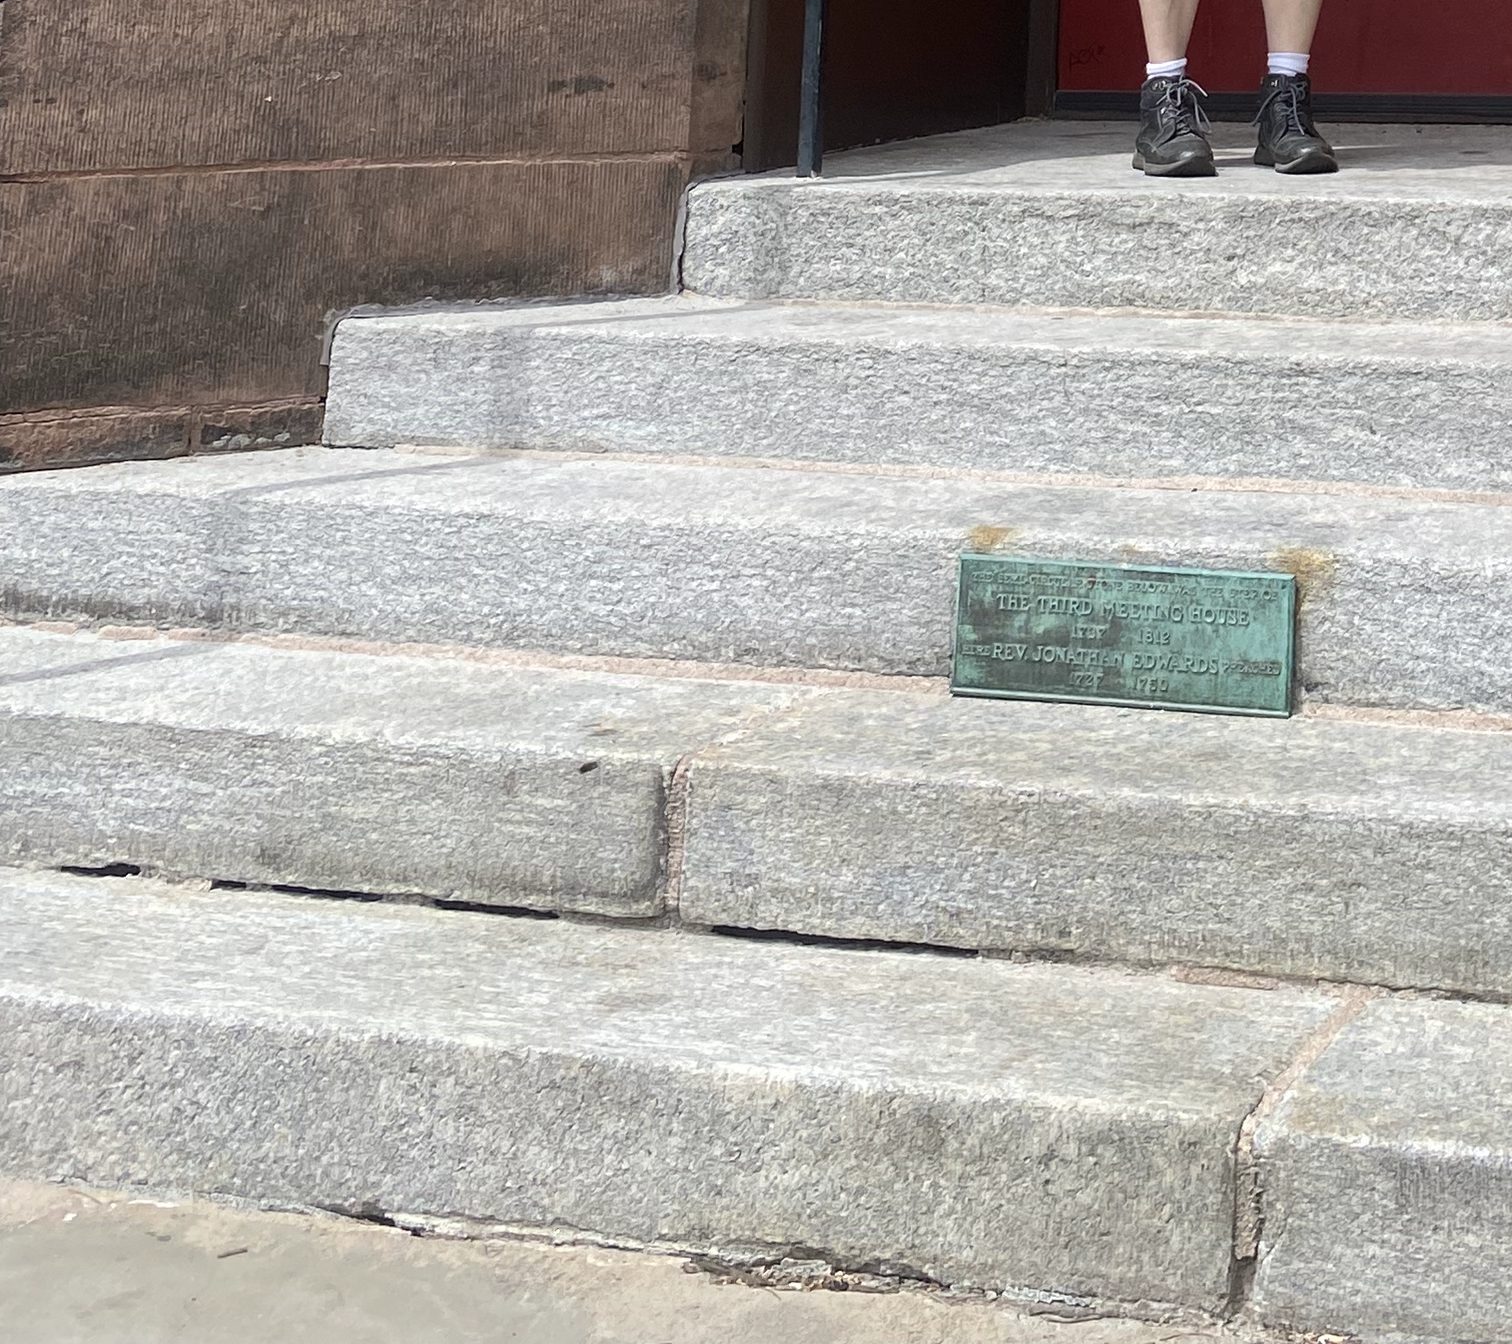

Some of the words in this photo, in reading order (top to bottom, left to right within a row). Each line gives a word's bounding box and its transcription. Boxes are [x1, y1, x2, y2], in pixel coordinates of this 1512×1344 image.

[1126, 580, 1168, 594] BELOW
[1261, 590, 1278, 601] OF
[996, 594, 1030, 611] THE
[1038, 597, 1094, 615] THIRD
[1101, 601, 1184, 622] MEETING
[1190, 607, 1251, 626] HOUSE
[1071, 622, 1109, 640] 1737
[1137, 628, 1171, 646] 1812
[991, 643, 1028, 660] REV.
[1033, 646, 1125, 667] JONATHAN
[1132, 653, 1219, 674] EDWARDS
[1068, 670, 1104, 687] 1727
[1135, 675, 1169, 692] 1750
